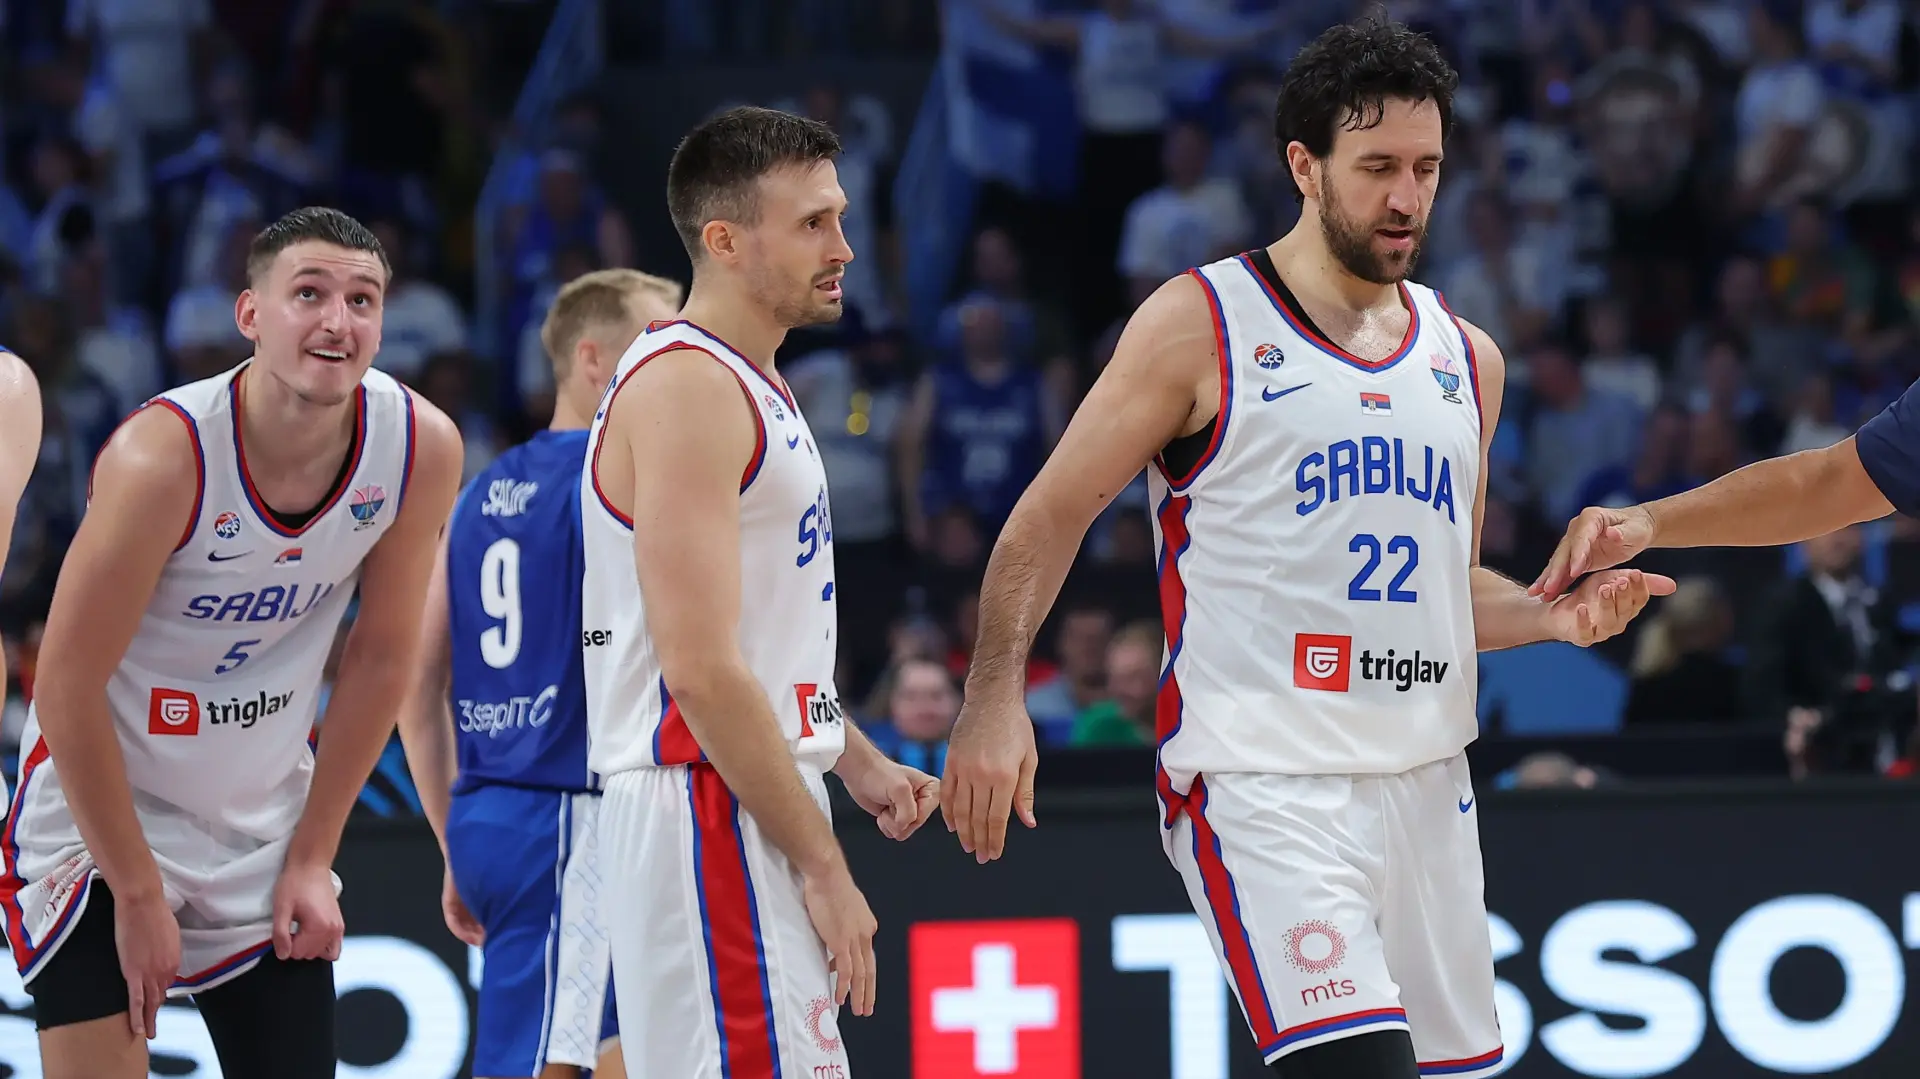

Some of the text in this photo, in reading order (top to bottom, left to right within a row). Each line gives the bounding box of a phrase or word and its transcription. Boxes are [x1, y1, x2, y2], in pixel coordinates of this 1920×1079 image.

[1296, 436, 1456, 526] SRBIJA
[1347, 533, 1419, 603] 22
[480, 537, 523, 670] 9
[214, 638, 262, 675] 5
[1360, 648, 1449, 692] triglav
[206, 689, 295, 729] triglav
[1300, 978, 1357, 1007] mts
[813, 1059, 845, 1079] mts
